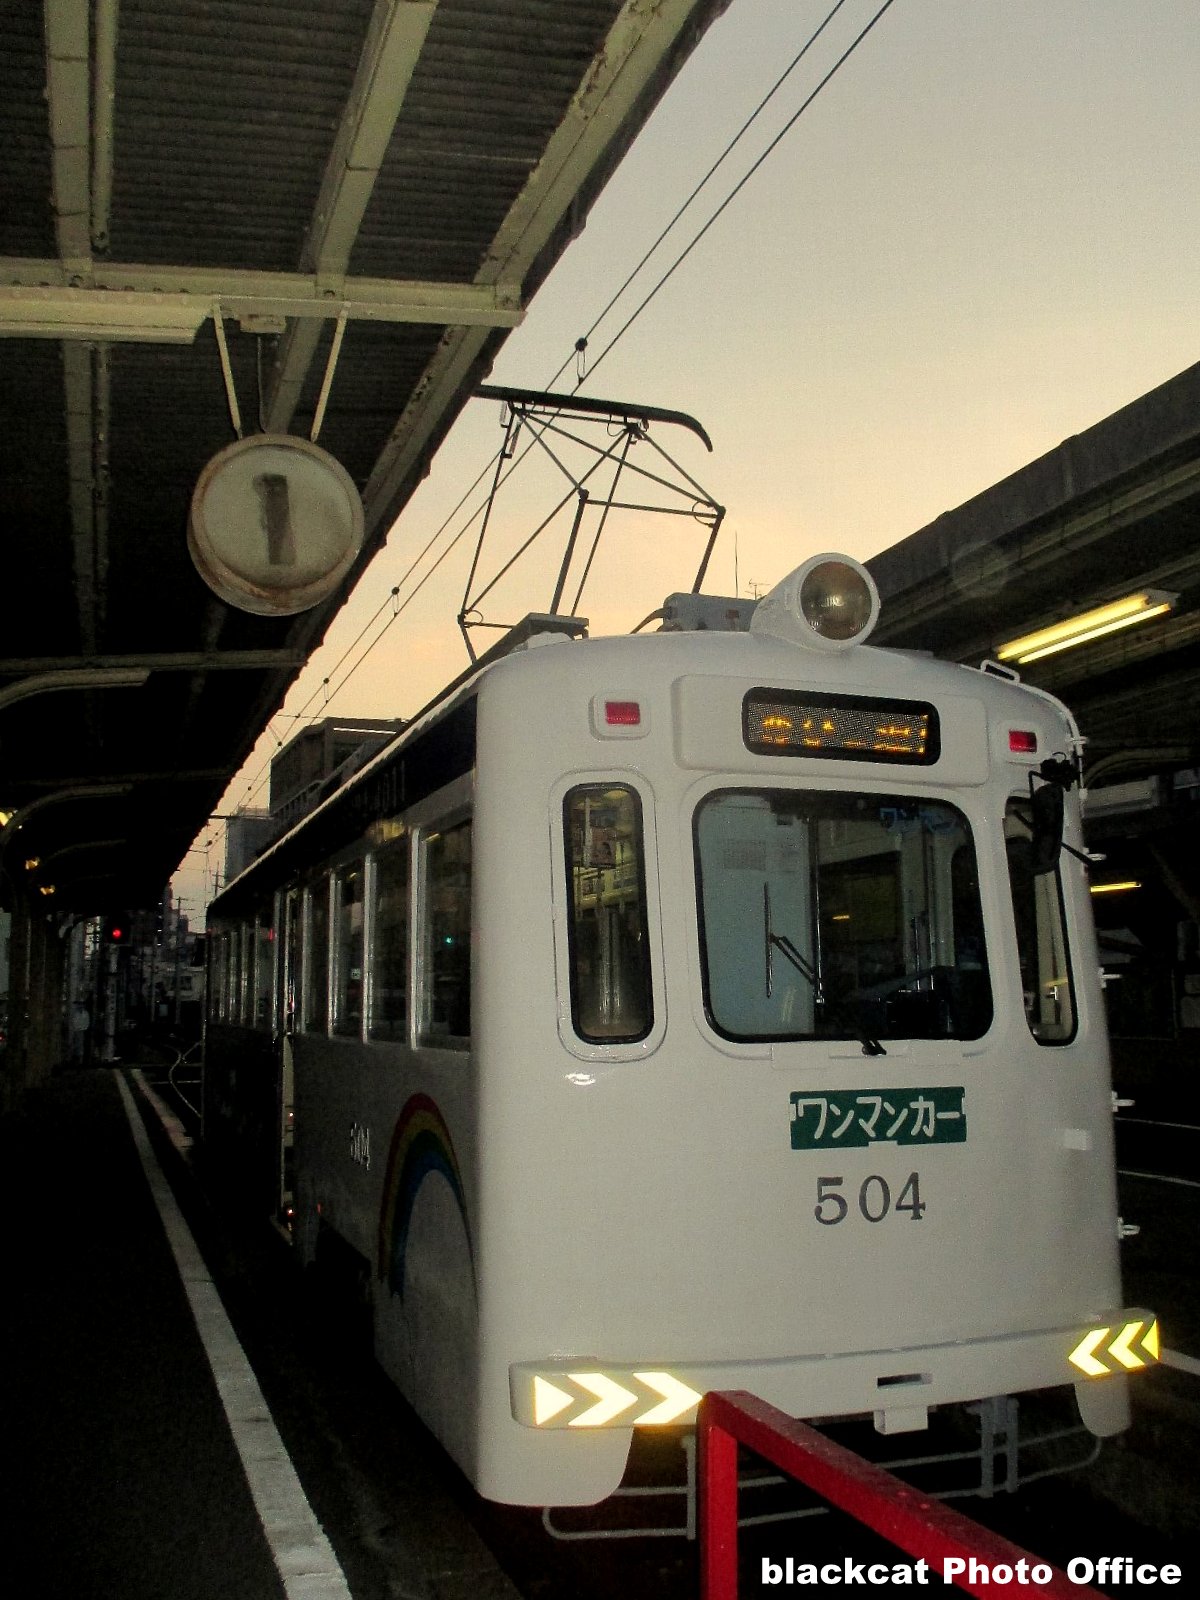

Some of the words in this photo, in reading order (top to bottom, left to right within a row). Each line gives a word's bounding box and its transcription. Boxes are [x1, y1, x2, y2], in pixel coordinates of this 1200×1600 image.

[252, 473, 297, 565] 1
[797, 1095, 961, 1139] ワンマンカー
[814, 1172, 926, 1226] 504
